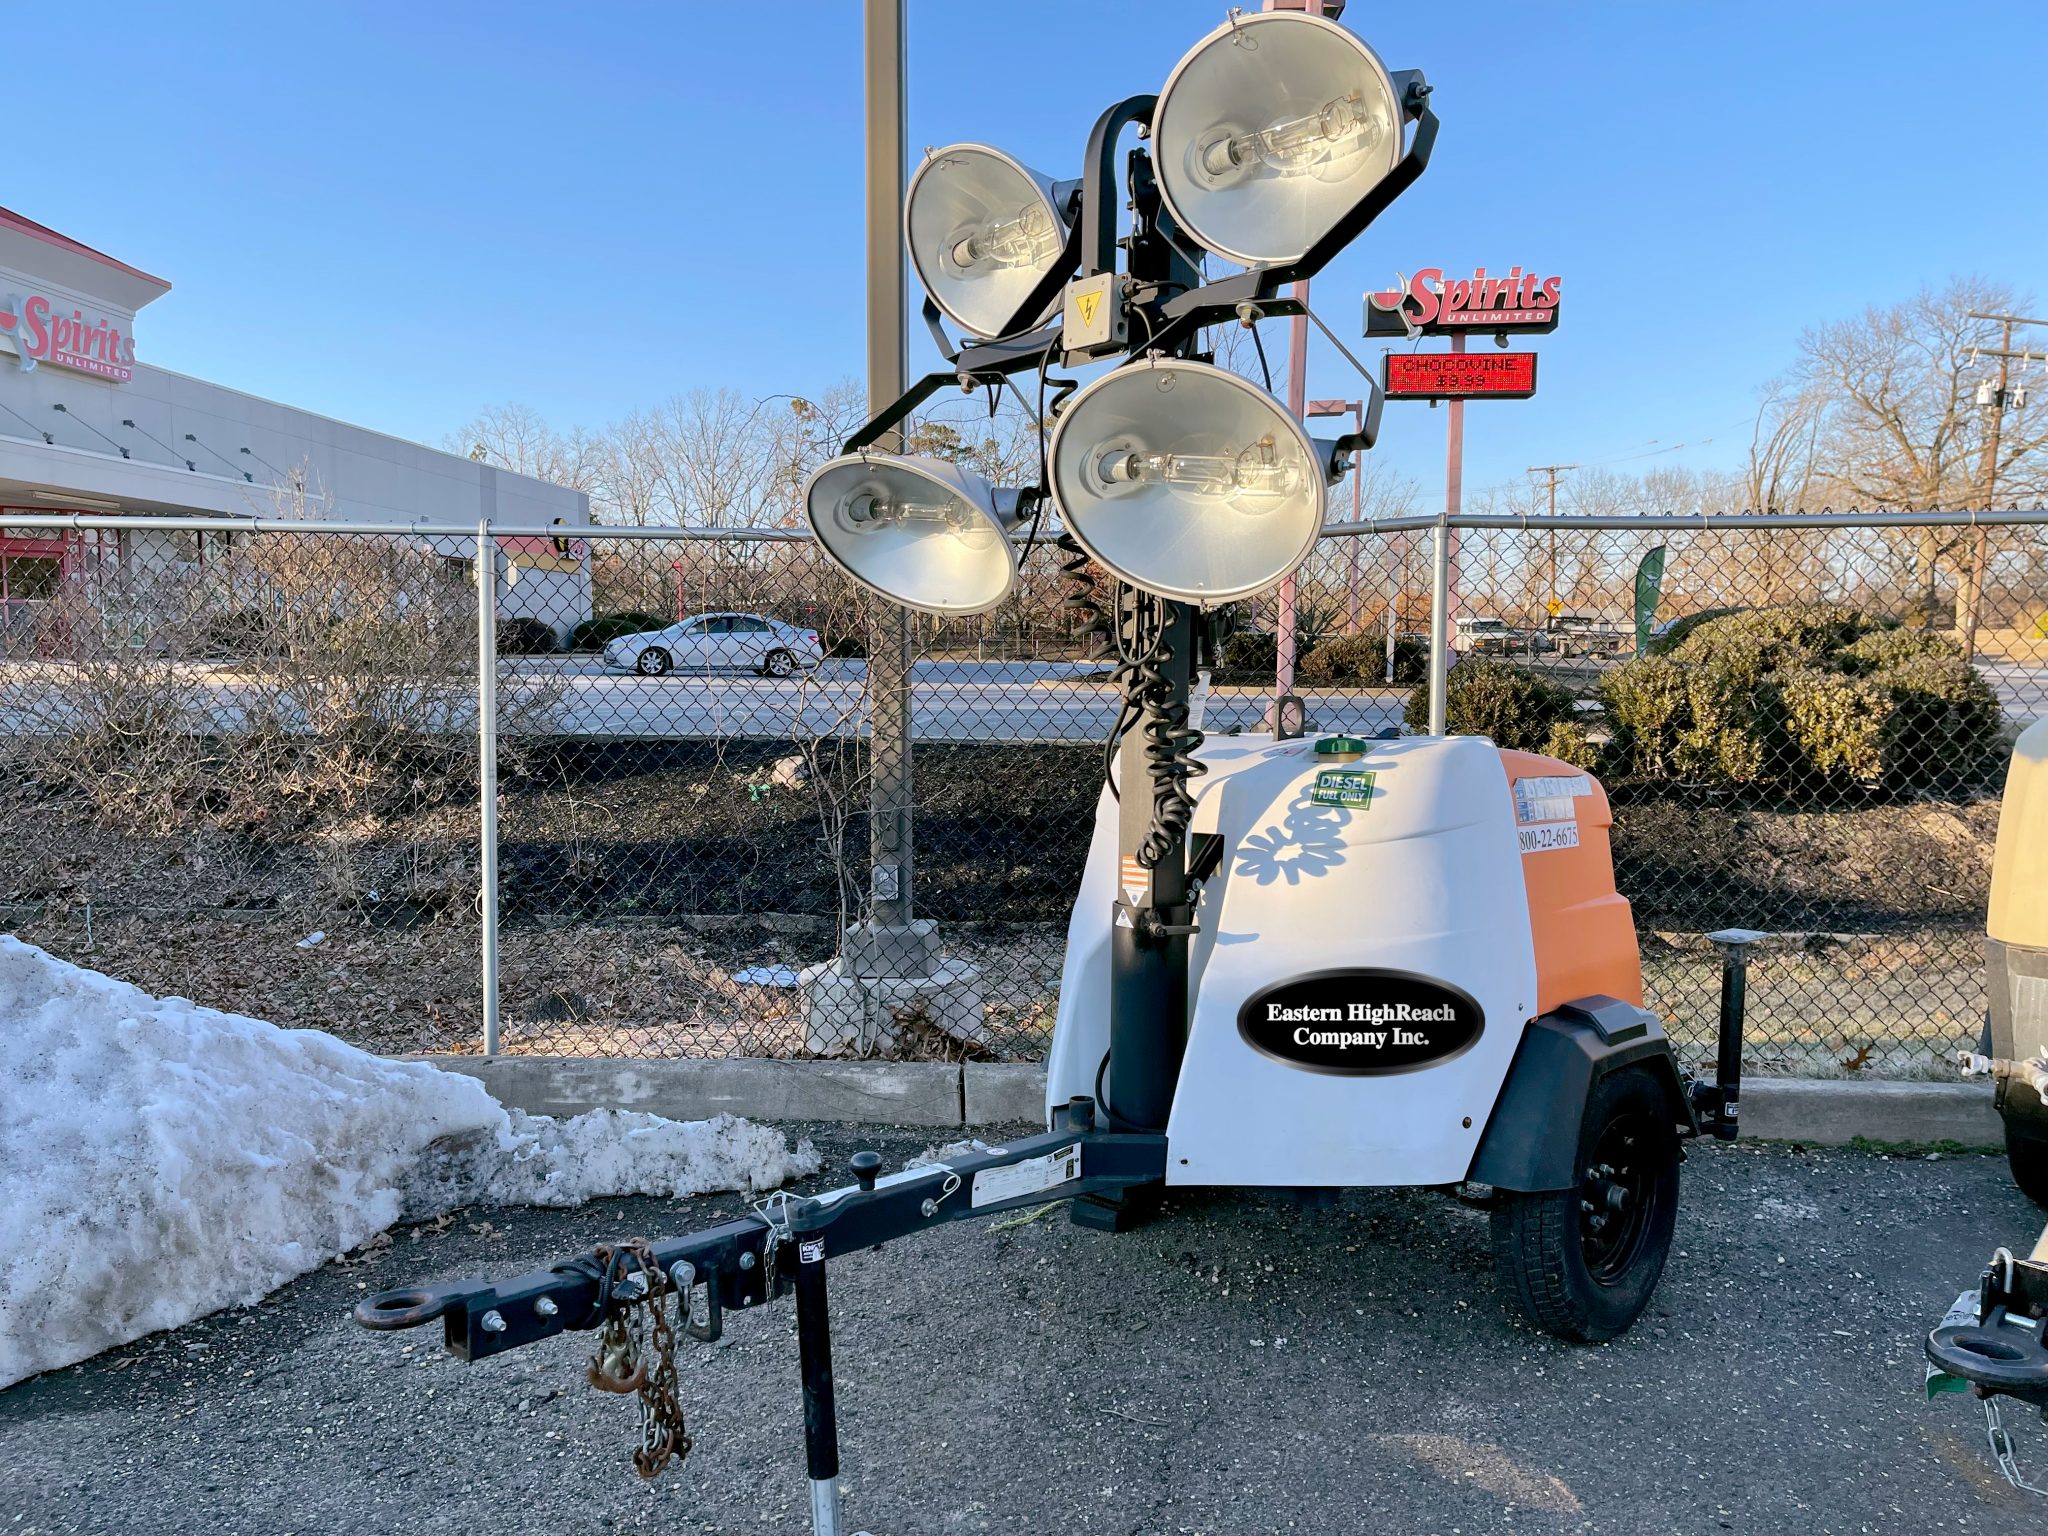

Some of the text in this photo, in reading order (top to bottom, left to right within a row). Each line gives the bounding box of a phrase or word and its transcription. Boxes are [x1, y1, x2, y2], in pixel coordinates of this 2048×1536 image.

[1405, 266, 1562, 325] Spirits
[1447, 312, 1546, 323] UNLIMITED
[24, 295, 136, 366] Spirits
[56, 354, 128, 378] UNLIMITED
[1402, 358, 1517, 372] CHOCOVINE
[1320, 775, 1367, 790] DIESEL
[1318, 789, 1364, 802] FUEL ONLY
[1519, 826, 1578, 851] 800-22-6675
